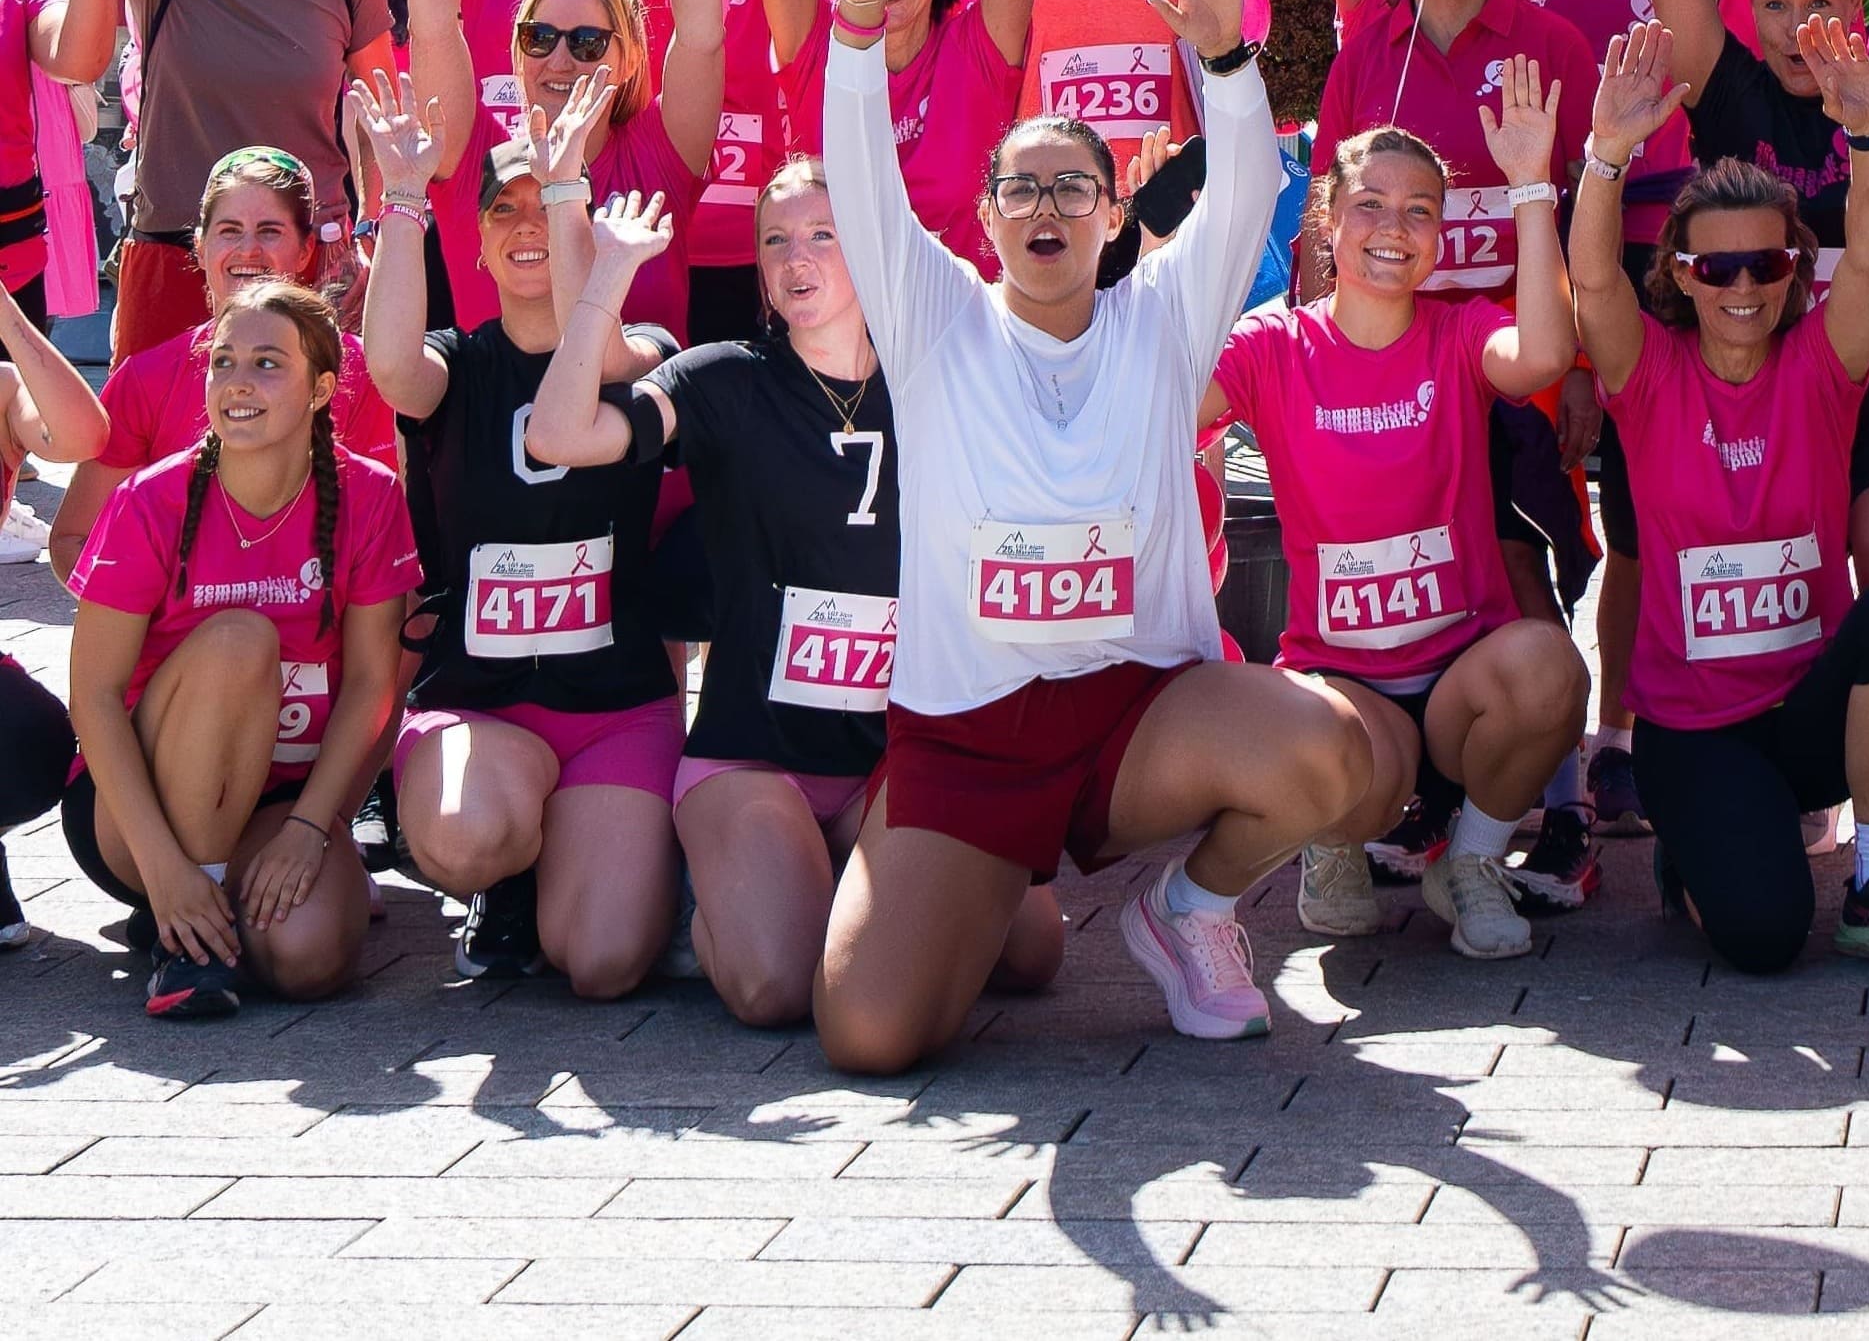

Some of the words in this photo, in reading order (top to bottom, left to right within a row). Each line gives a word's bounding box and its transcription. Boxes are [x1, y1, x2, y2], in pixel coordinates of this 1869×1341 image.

[1054, 80, 1159, 120] 4236
[830, 430, 884, 525] 7
[480, 581, 596, 629] 4171
[984, 567, 1117, 616] 4194
[1330, 571, 1442, 625] 4141
[1696, 579, 1808, 631] 4140
[792, 634, 896, 683] 4172
